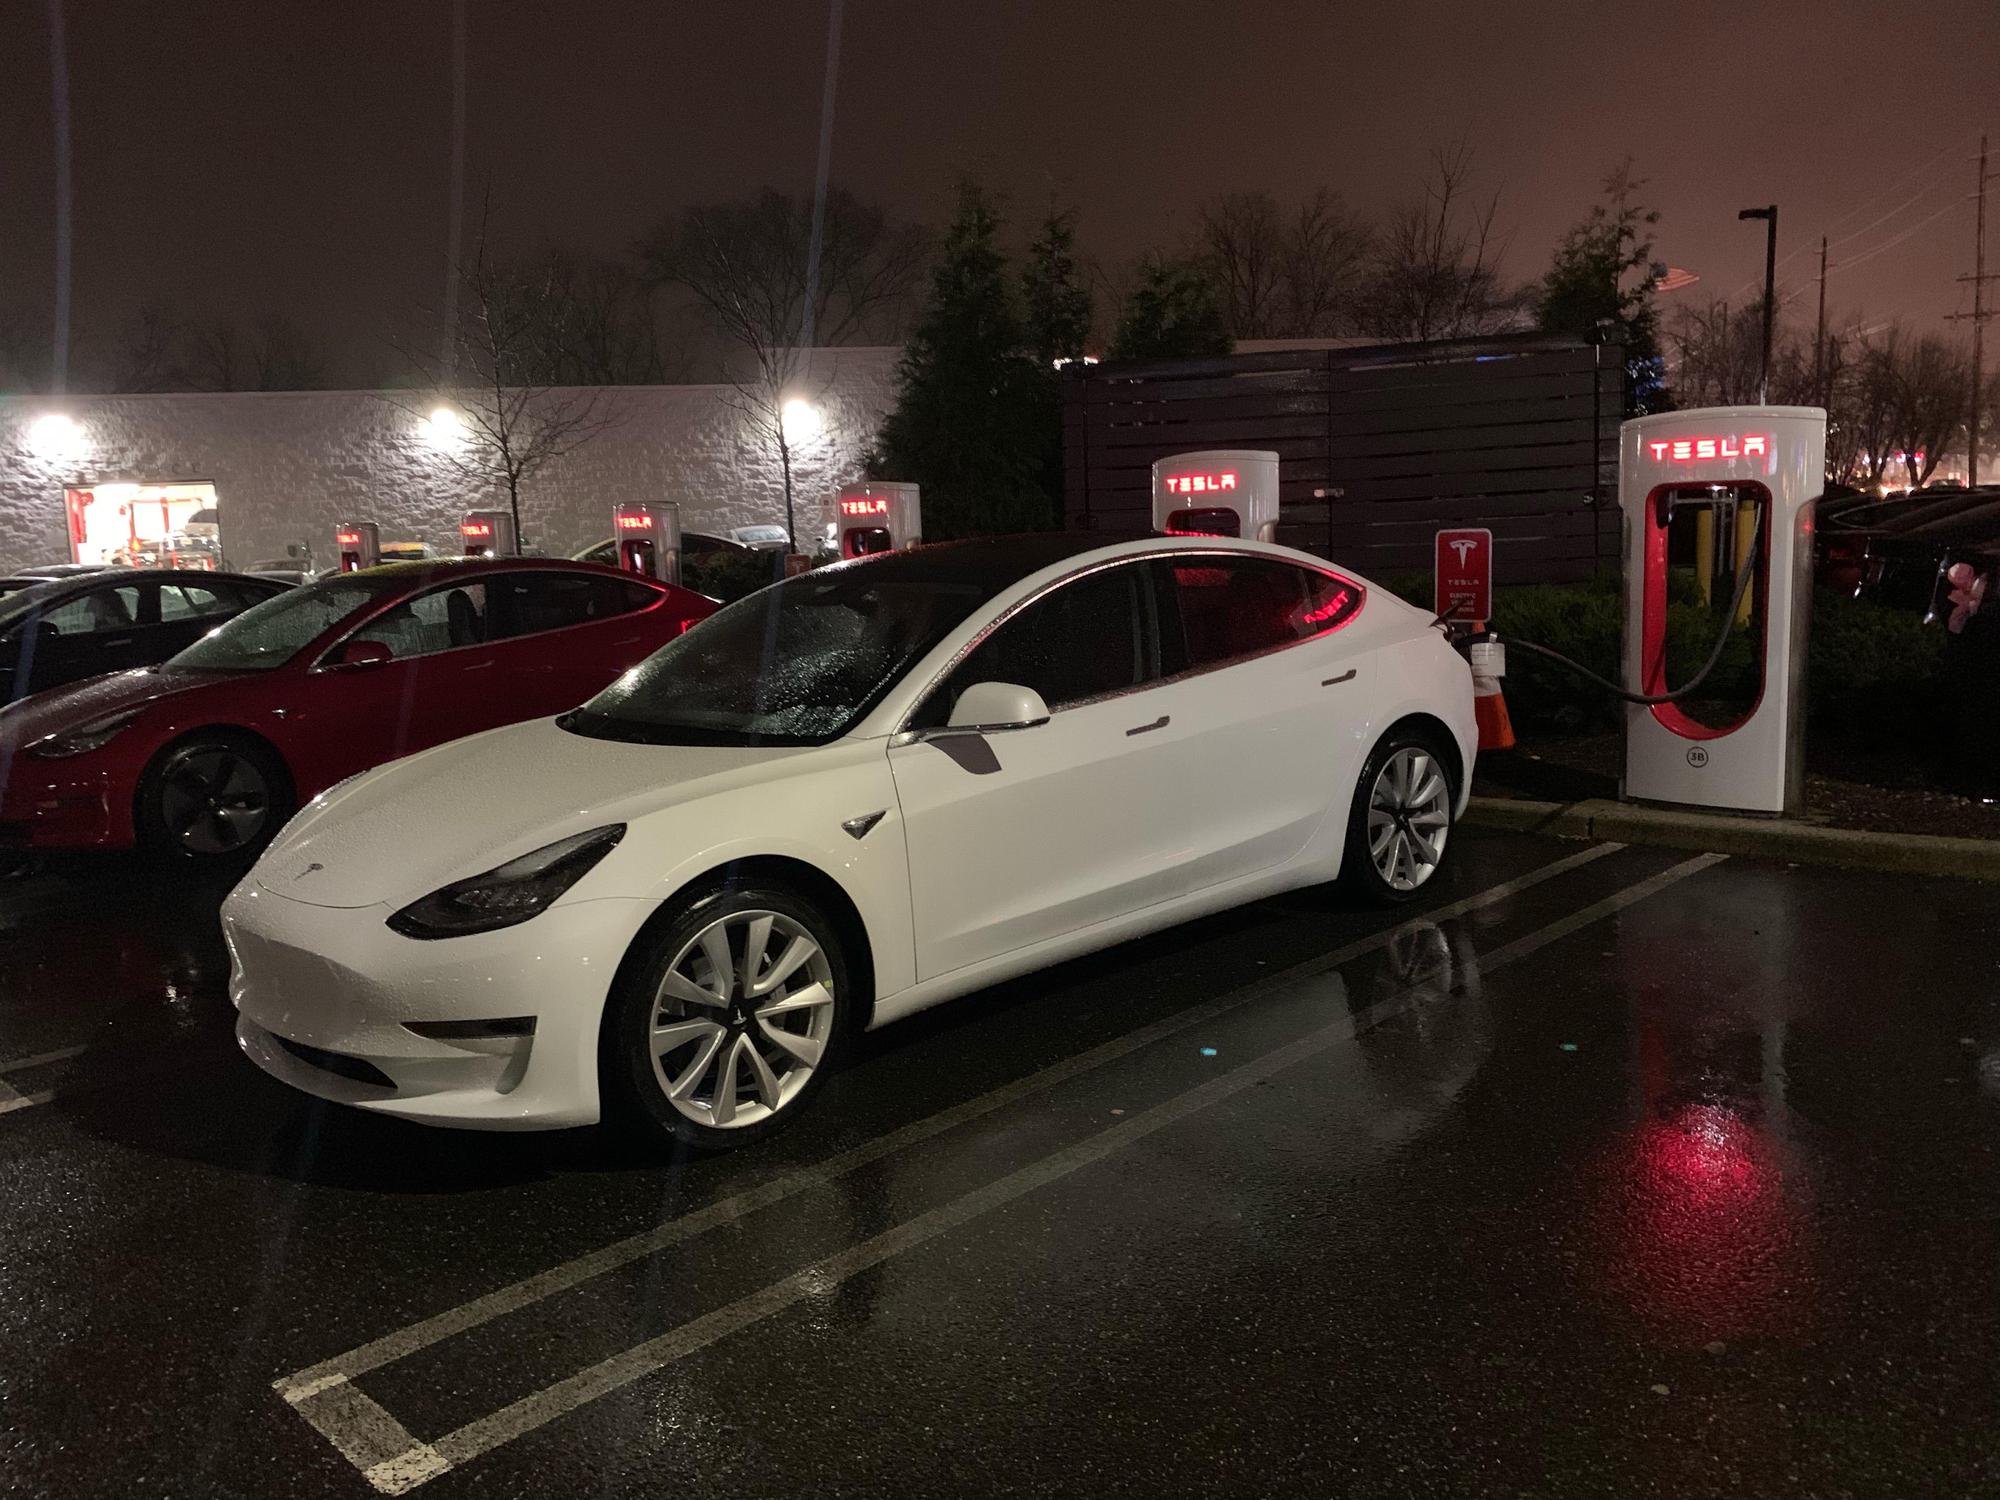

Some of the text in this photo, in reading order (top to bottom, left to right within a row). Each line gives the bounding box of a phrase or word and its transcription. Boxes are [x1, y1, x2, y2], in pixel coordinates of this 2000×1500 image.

[1650, 437, 1765, 461] TESLA
[1166, 474, 1236, 494] TESLA
[841, 500, 887, 515] TESLA
[618, 516, 653, 529] TESLA
